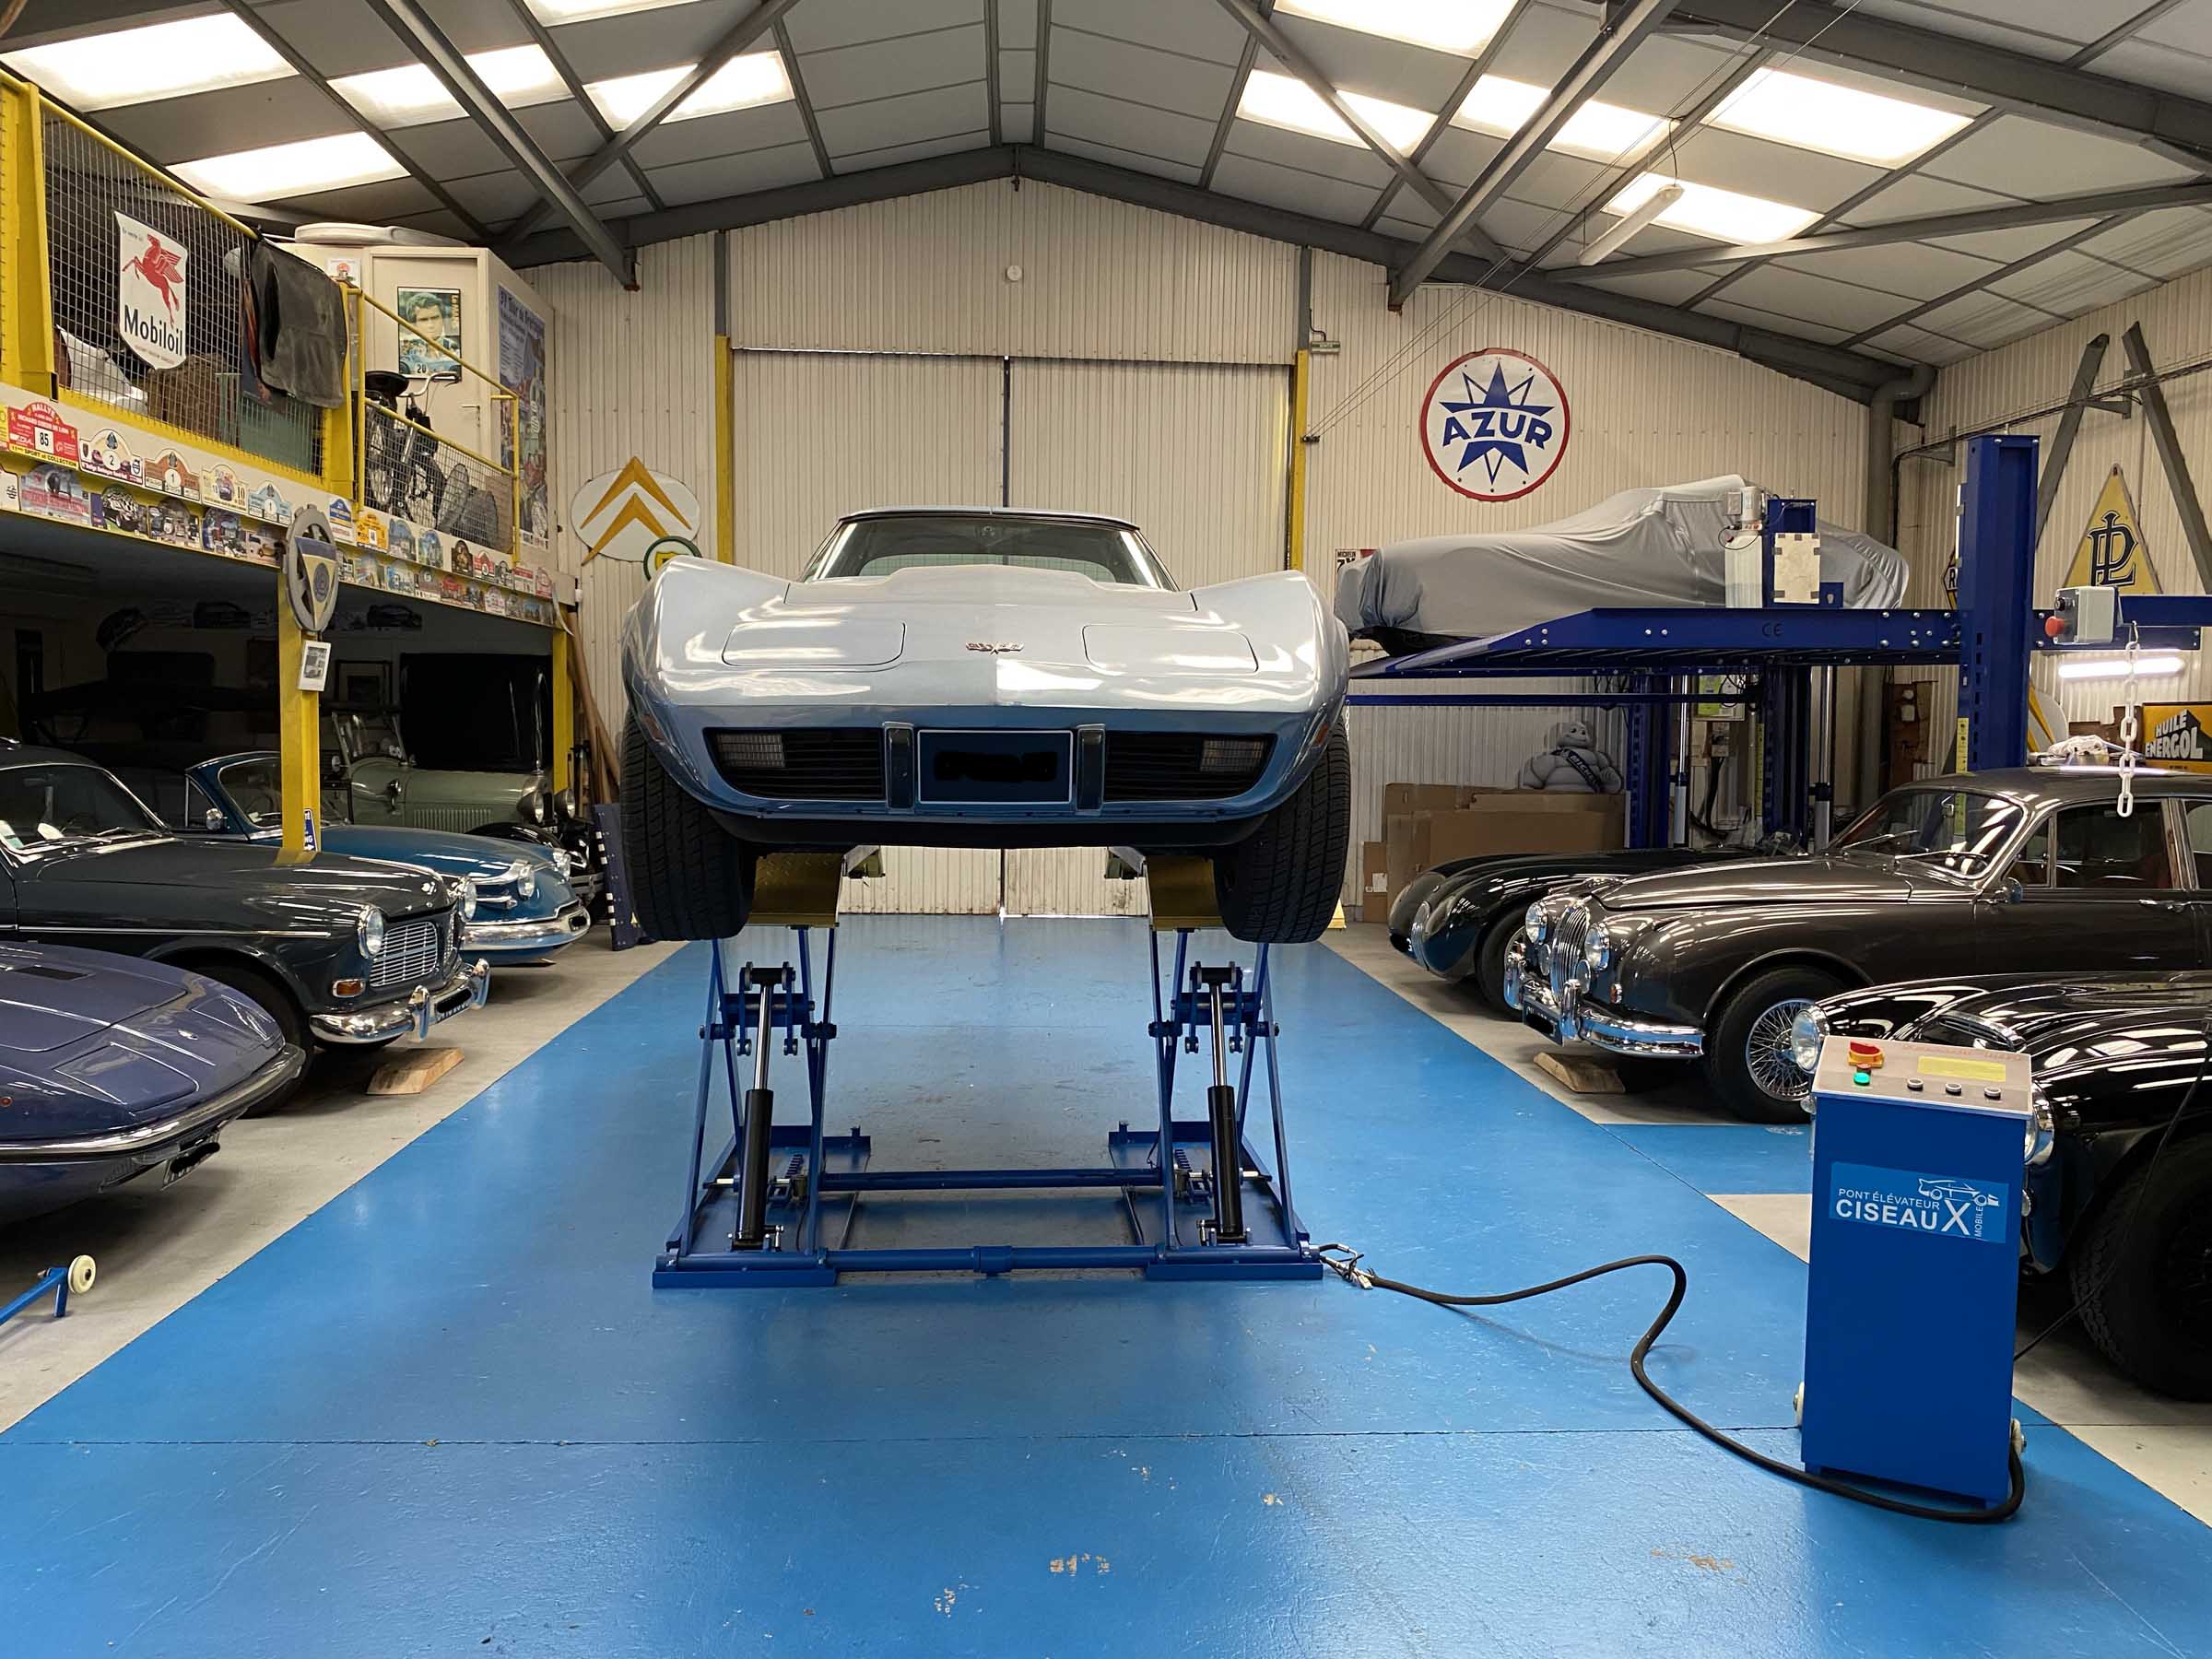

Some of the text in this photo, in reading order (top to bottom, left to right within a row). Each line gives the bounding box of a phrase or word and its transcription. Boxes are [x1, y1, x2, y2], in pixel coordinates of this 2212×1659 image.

[124, 305, 182, 356] Mobiloil
[417, 364, 427, 374] 20
[40, 432, 49, 447] 85
[1442, 411, 1552, 450] AZUR
[47, 454, 77, 468] COLLECTION
[110, 454, 115, 466] 2
[171, 473, 176, 484] 1
[2155, 708, 2188, 738] HUILE
[2145, 726, 2204, 759] ENERGOL
[1838, 1188, 1940, 1210] PONT ÉLÉVATEUR
[1835, 1198, 1971, 1236] CISEAUX
[1973, 1206, 1984, 1238] MOBILE
